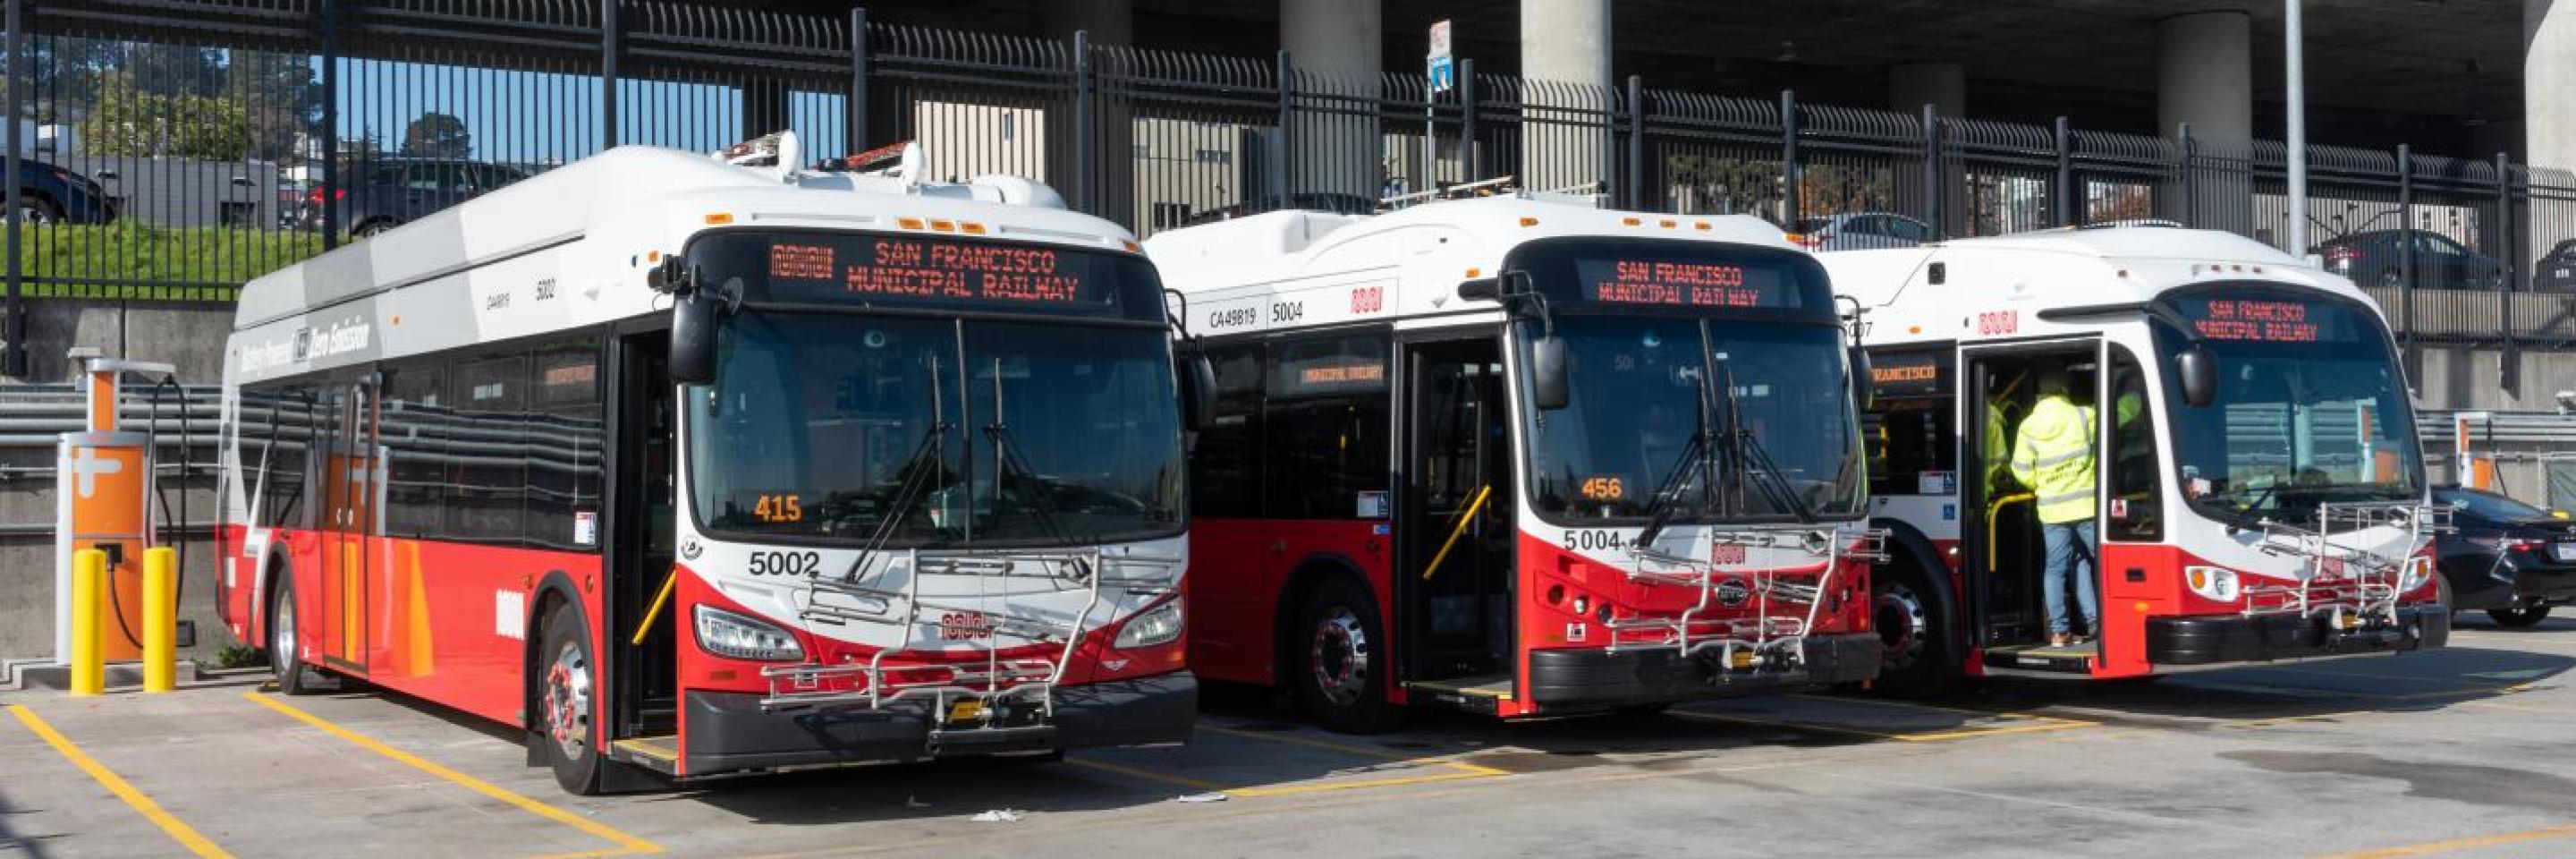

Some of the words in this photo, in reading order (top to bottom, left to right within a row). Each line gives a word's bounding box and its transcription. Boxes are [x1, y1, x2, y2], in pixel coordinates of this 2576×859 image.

[875, 242, 921, 266] SAN
[931, 245, 1055, 274] FRANCISCO
[847, 266, 972, 297] MUNICIPAL
[983, 273, 1079, 302] RAILWAY
[1616, 260, 1649, 282] SAN
[1656, 262, 1742, 286] FRANCISCO
[536, 278, 555, 302] 5002
[1598, 282, 1681, 304] MUNICIPAL
[1210, 307, 1257, 328] CA49819
[1273, 300, 1303, 323] 5004
[2208, 300, 2234, 319] SAN
[2238, 301, 2305, 322] FRANCISCO
[2265, 321, 2318, 342] RAILWAY
[1581, 477, 1623, 499] 456
[754, 495, 802, 523] 415
[1563, 530, 1621, 551] 5004
[749, 550, 820, 576] 5002
